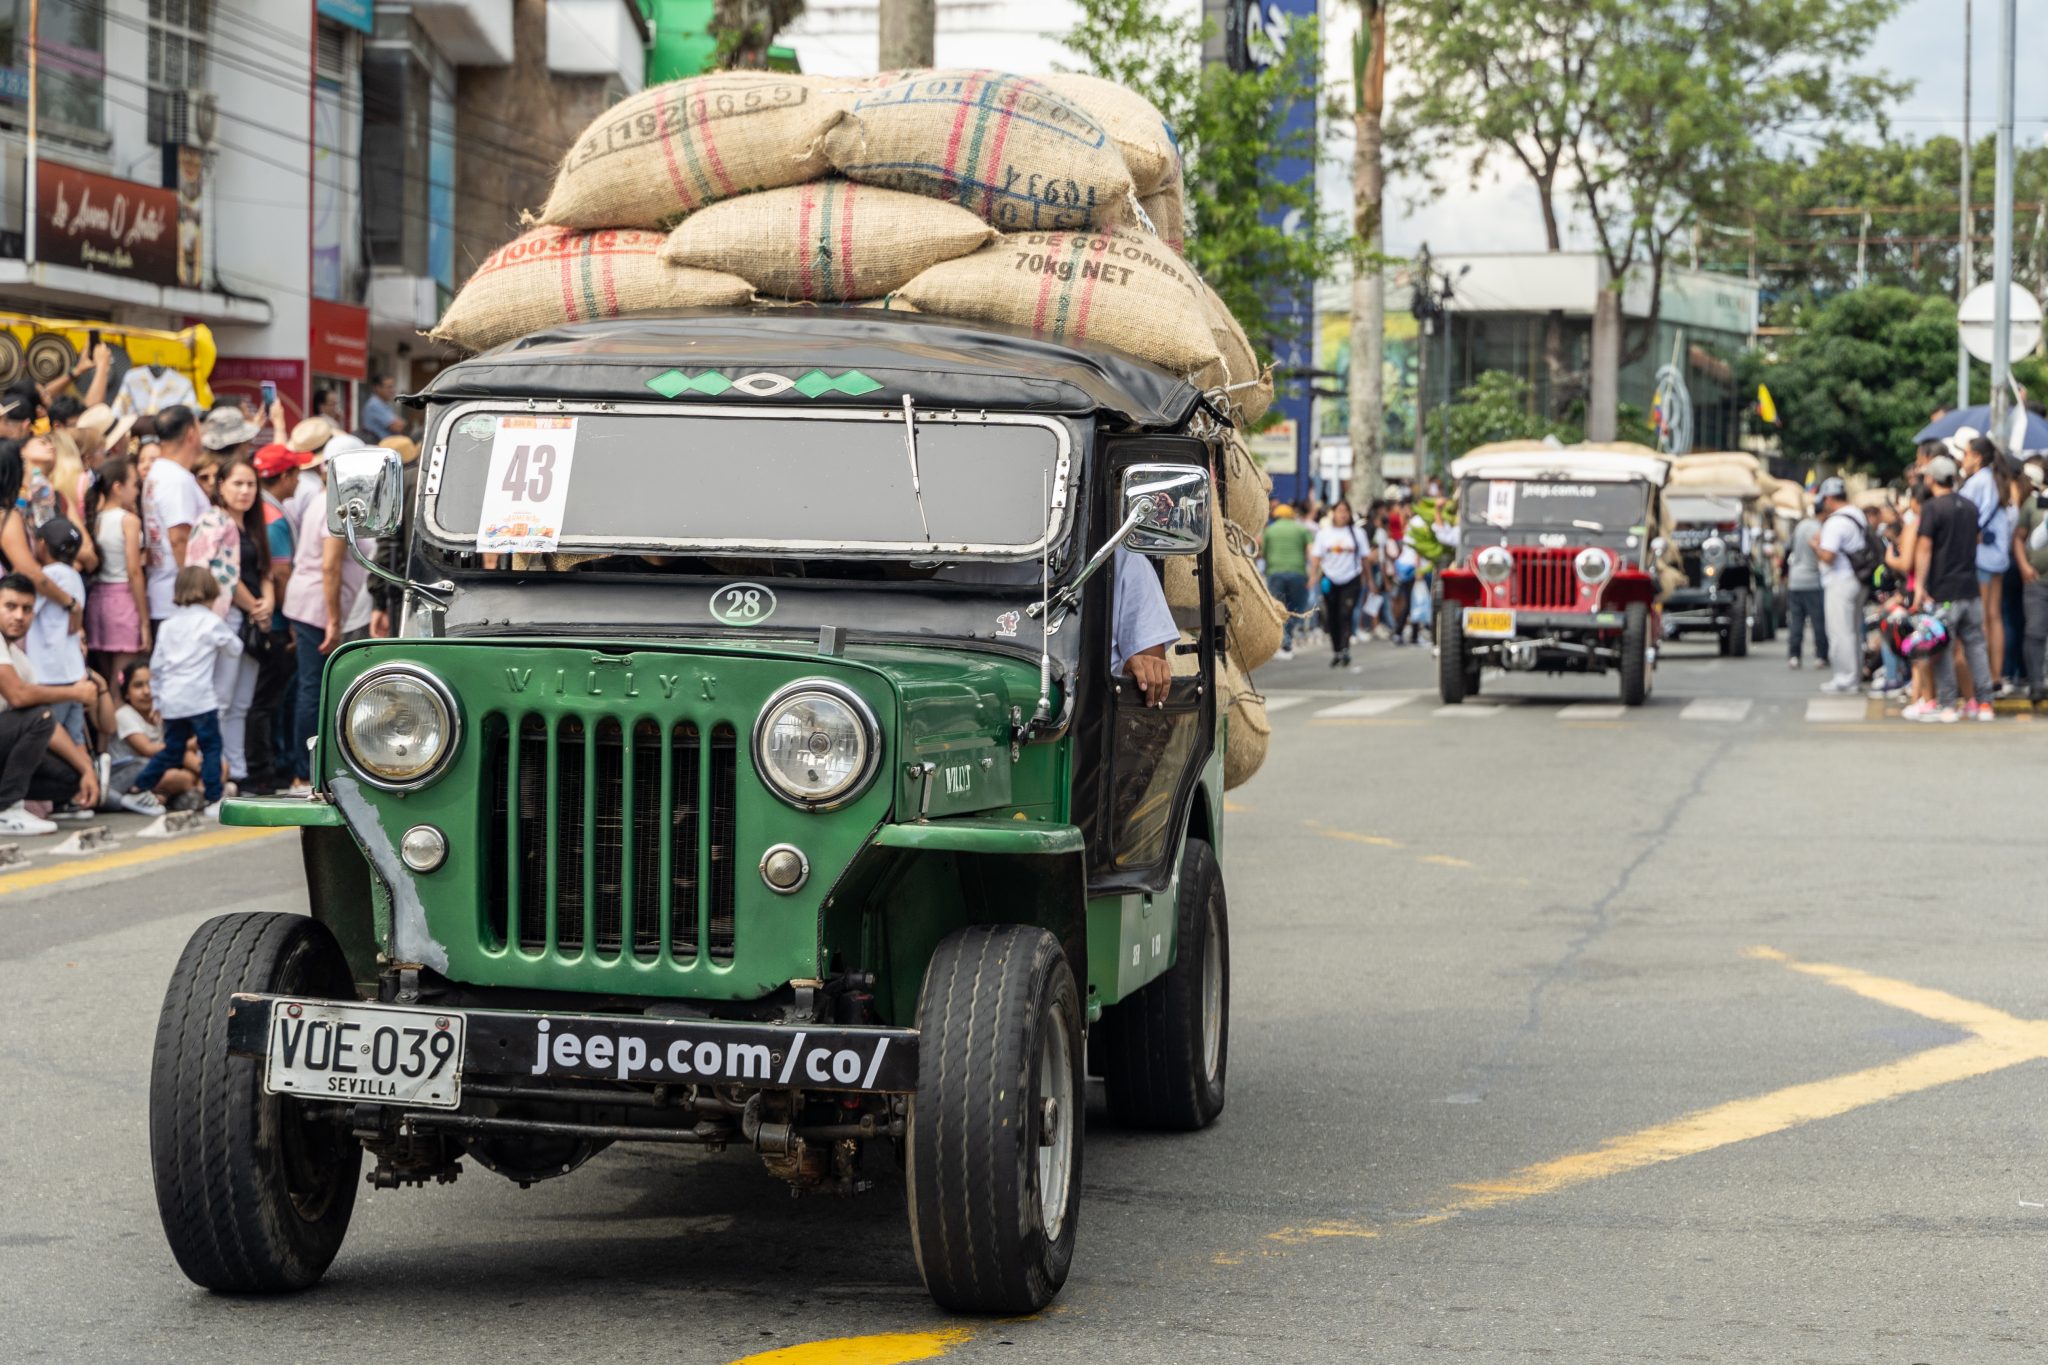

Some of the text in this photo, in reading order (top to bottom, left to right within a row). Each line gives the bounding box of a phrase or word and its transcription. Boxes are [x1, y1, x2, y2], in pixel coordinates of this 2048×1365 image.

[1015, 252, 1136, 286] 70kg NET
[502, 444, 557, 502] 43
[725, 590, 761, 618] 28
[281, 1018, 456, 1080] VOE 039
[531, 1018, 891, 1089] jeep.com/co/
[327, 1076, 396, 1096] SEVILLA
